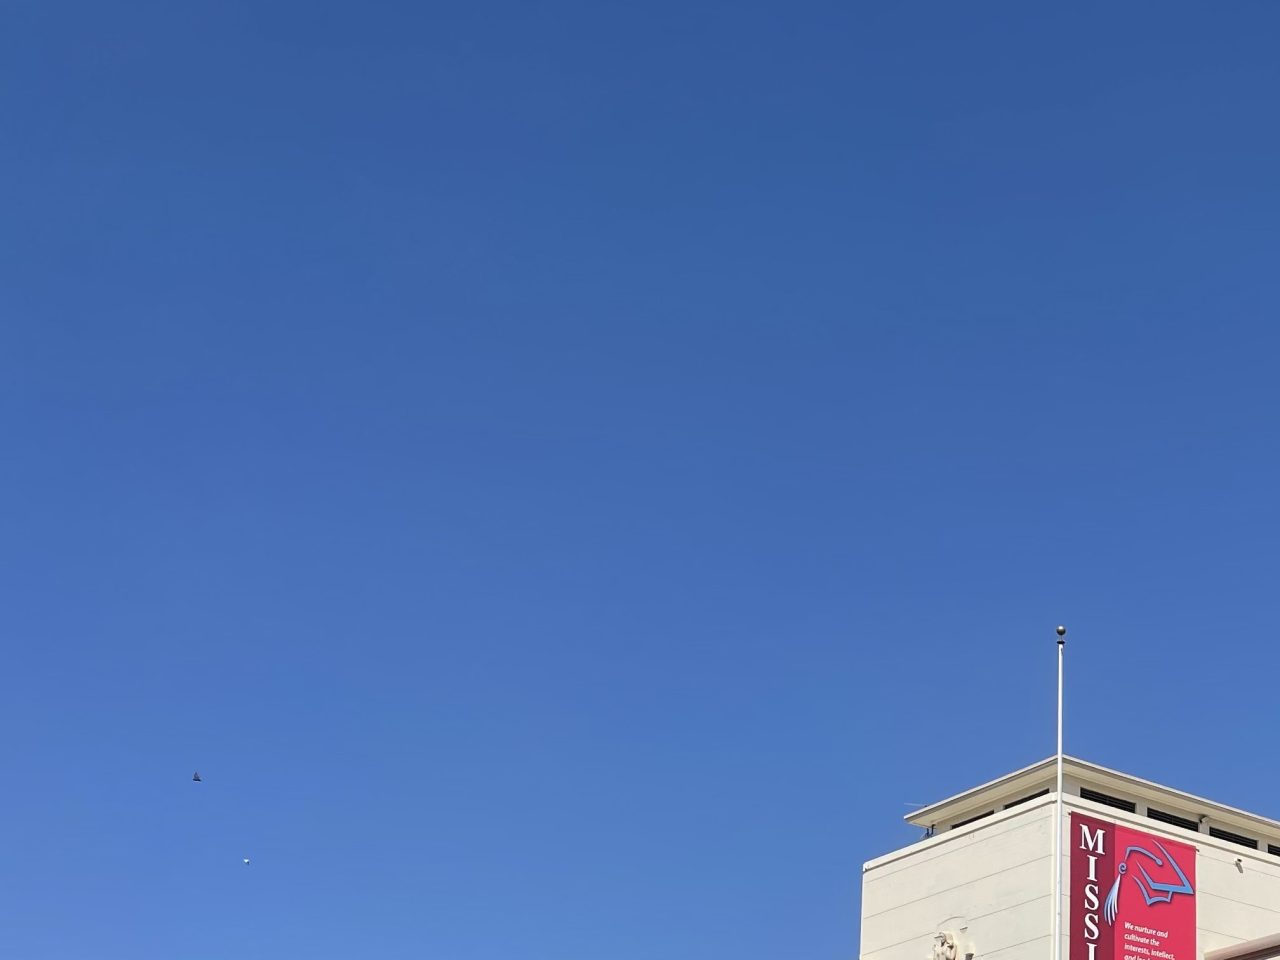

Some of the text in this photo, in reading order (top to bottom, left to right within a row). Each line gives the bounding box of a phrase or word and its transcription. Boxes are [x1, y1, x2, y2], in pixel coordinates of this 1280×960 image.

[1124, 921, 1134, 930] We
[1134, 925, 1156, 935] nurture
[1124, 933, 1160, 946] cultivate the
